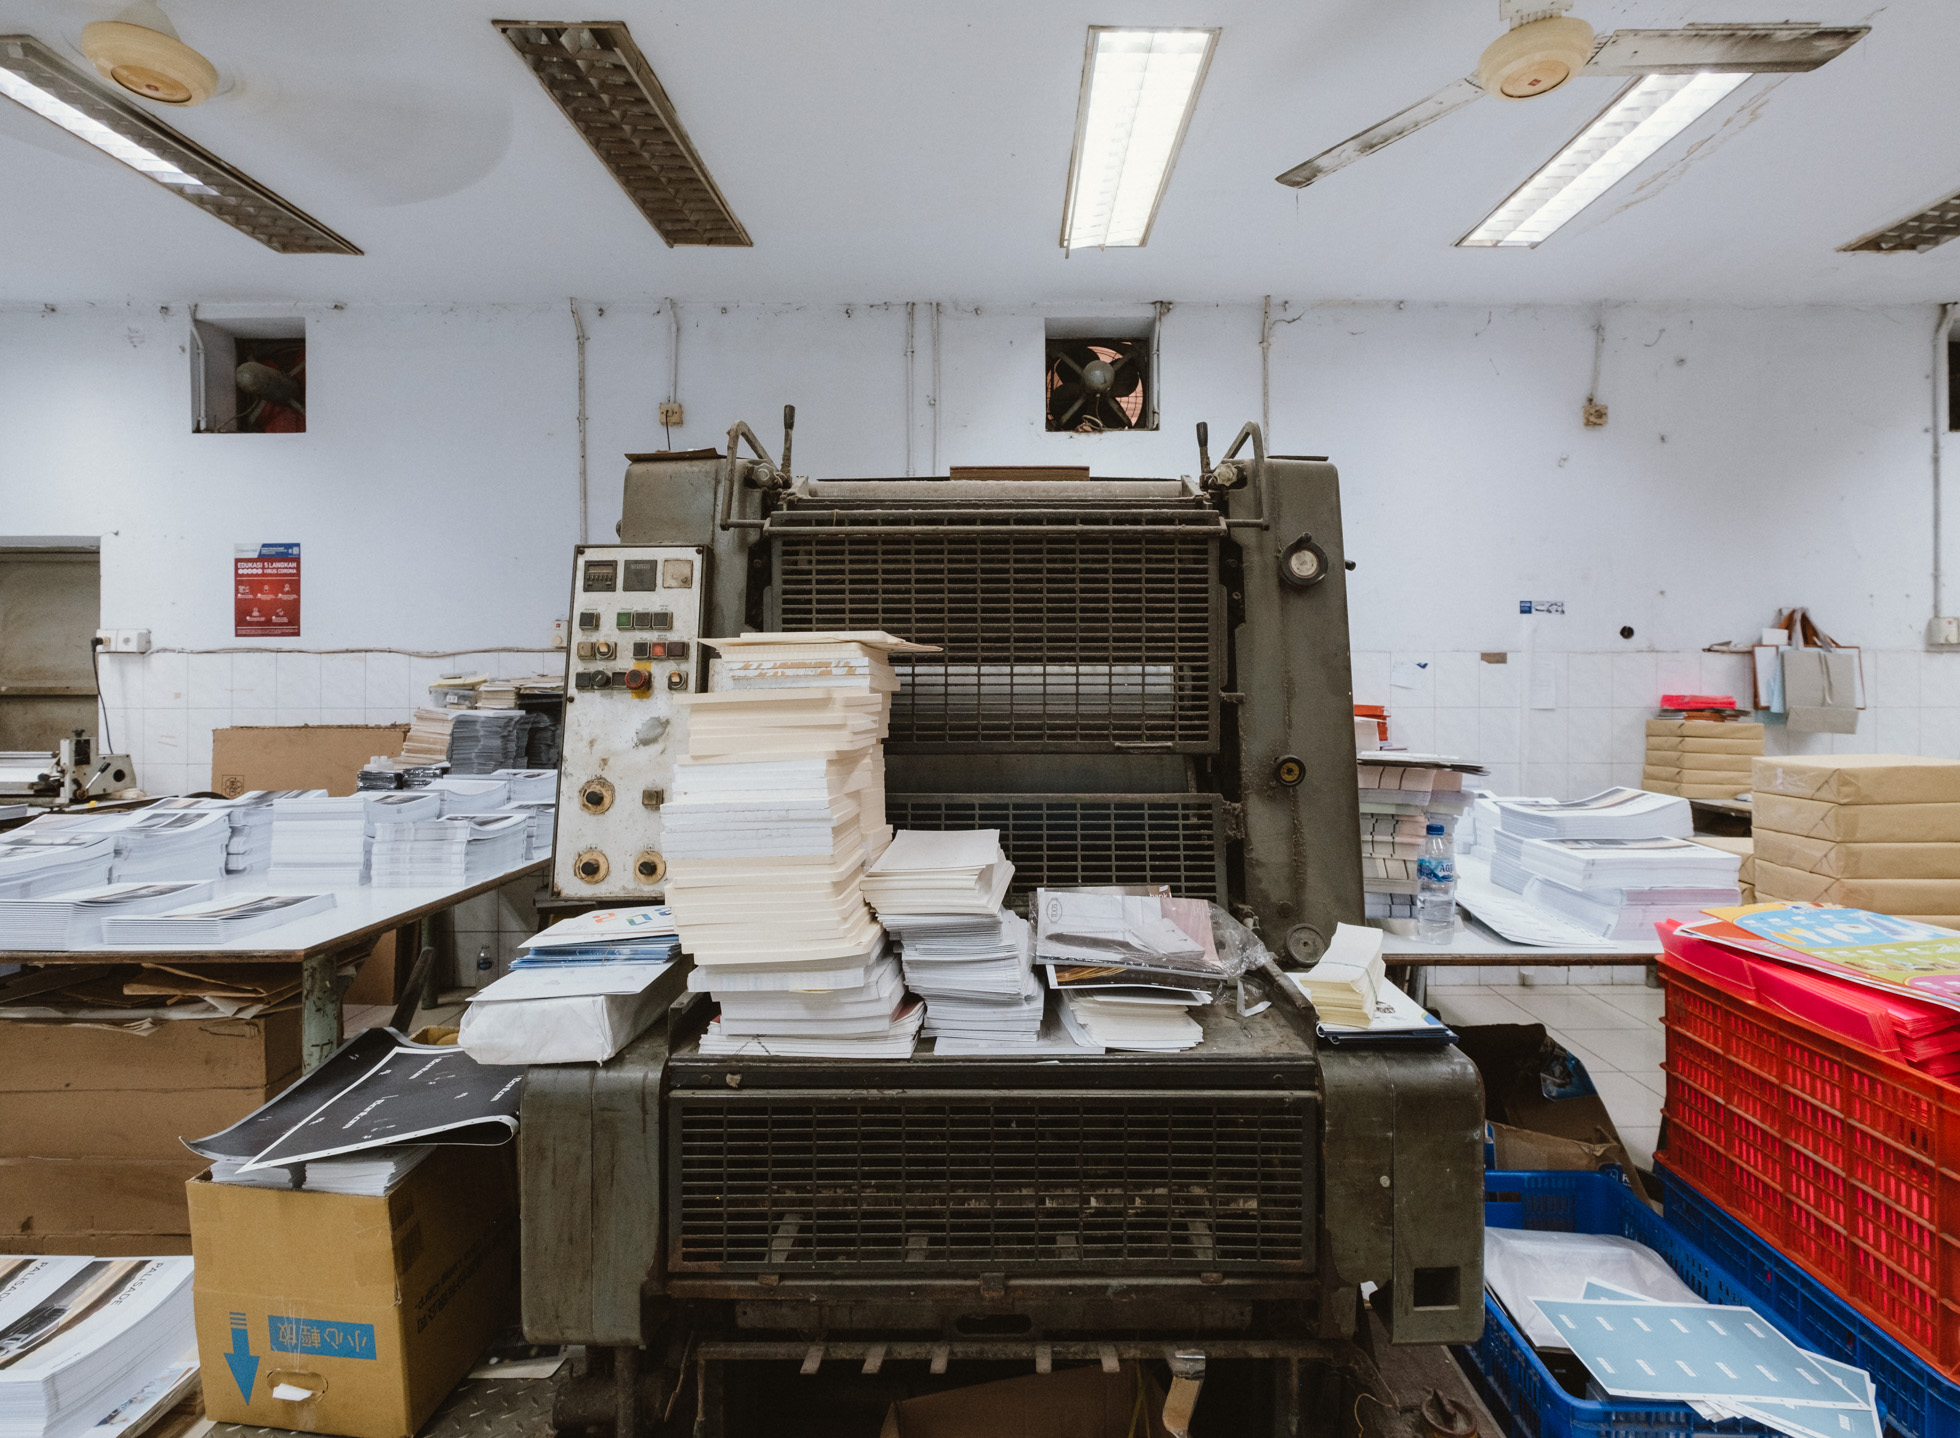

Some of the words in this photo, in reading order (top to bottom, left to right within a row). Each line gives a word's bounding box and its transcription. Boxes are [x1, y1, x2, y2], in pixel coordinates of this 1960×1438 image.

[0, 1262, 49, 1302] PALISAD
[110, 1262, 165, 1306] PALISADE
[277, 1322, 367, 1352] 小心輕放
